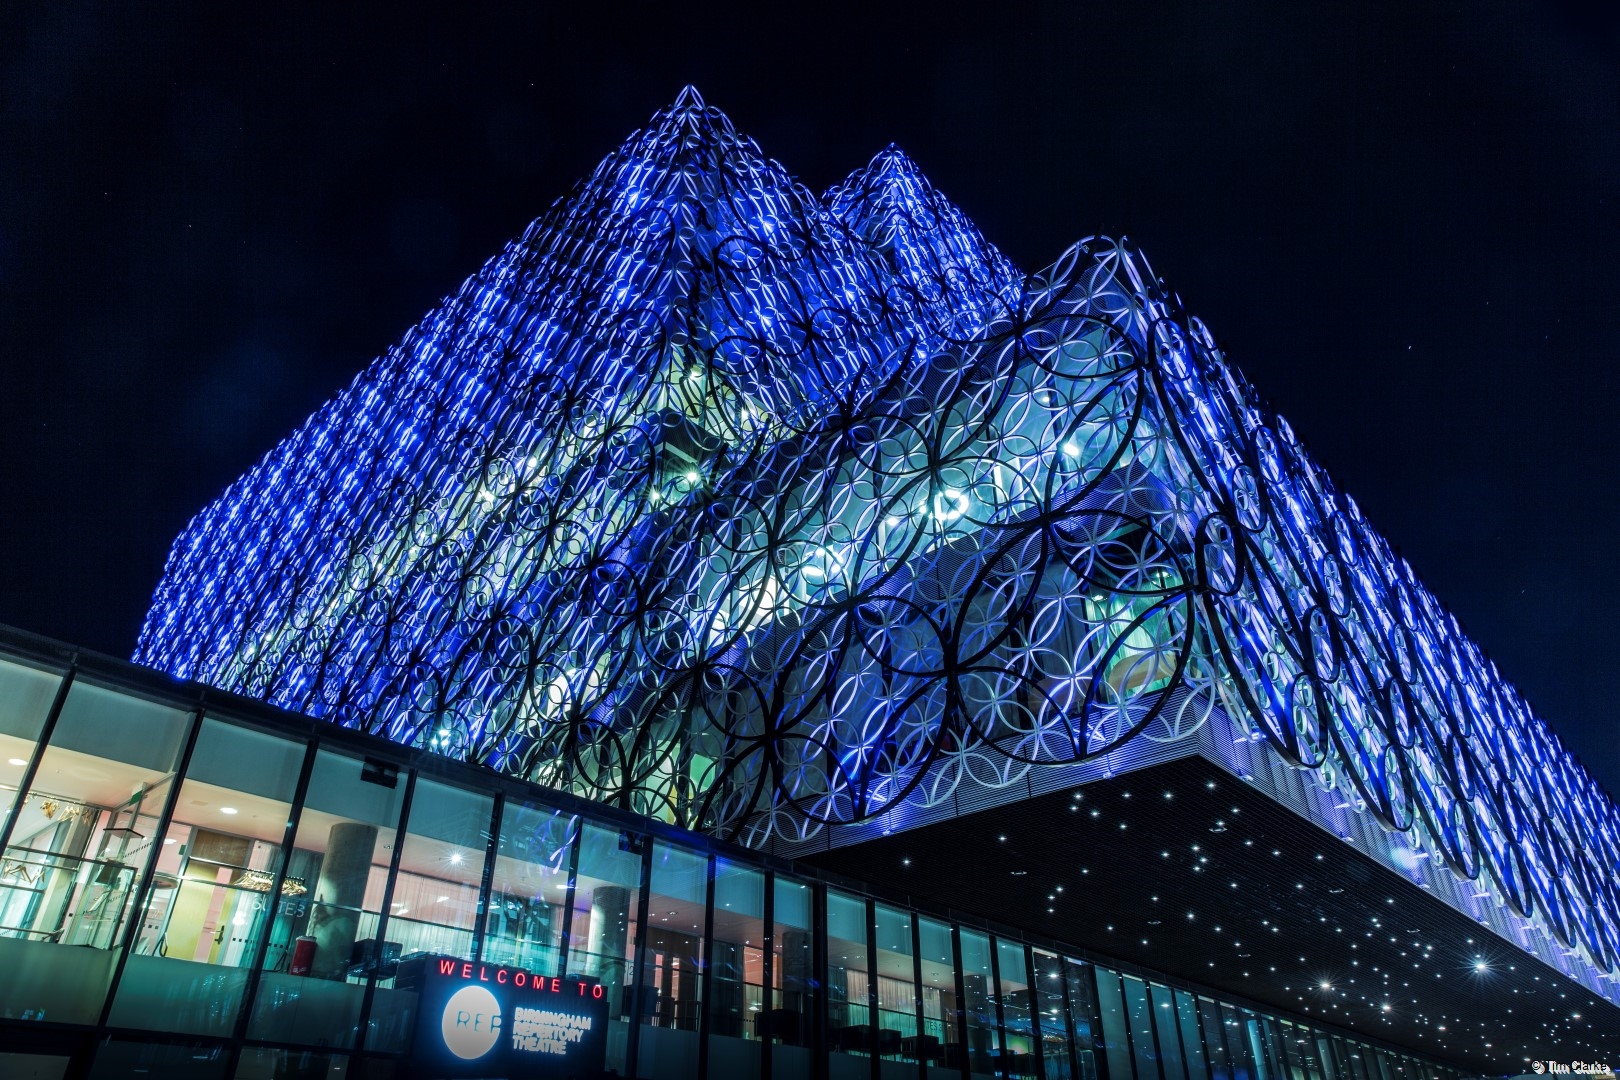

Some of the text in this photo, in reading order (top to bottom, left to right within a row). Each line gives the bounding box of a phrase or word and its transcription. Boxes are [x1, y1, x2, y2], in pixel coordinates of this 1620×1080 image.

[440, 959, 603, 999] WELCOME TO
[456, 1010, 502, 1034] REP
[514, 1007, 592, 1031] BIRMINGHAM
[512, 1021, 584, 1043] REPERTORY
[512, 1035, 567, 1055] THEATRE
